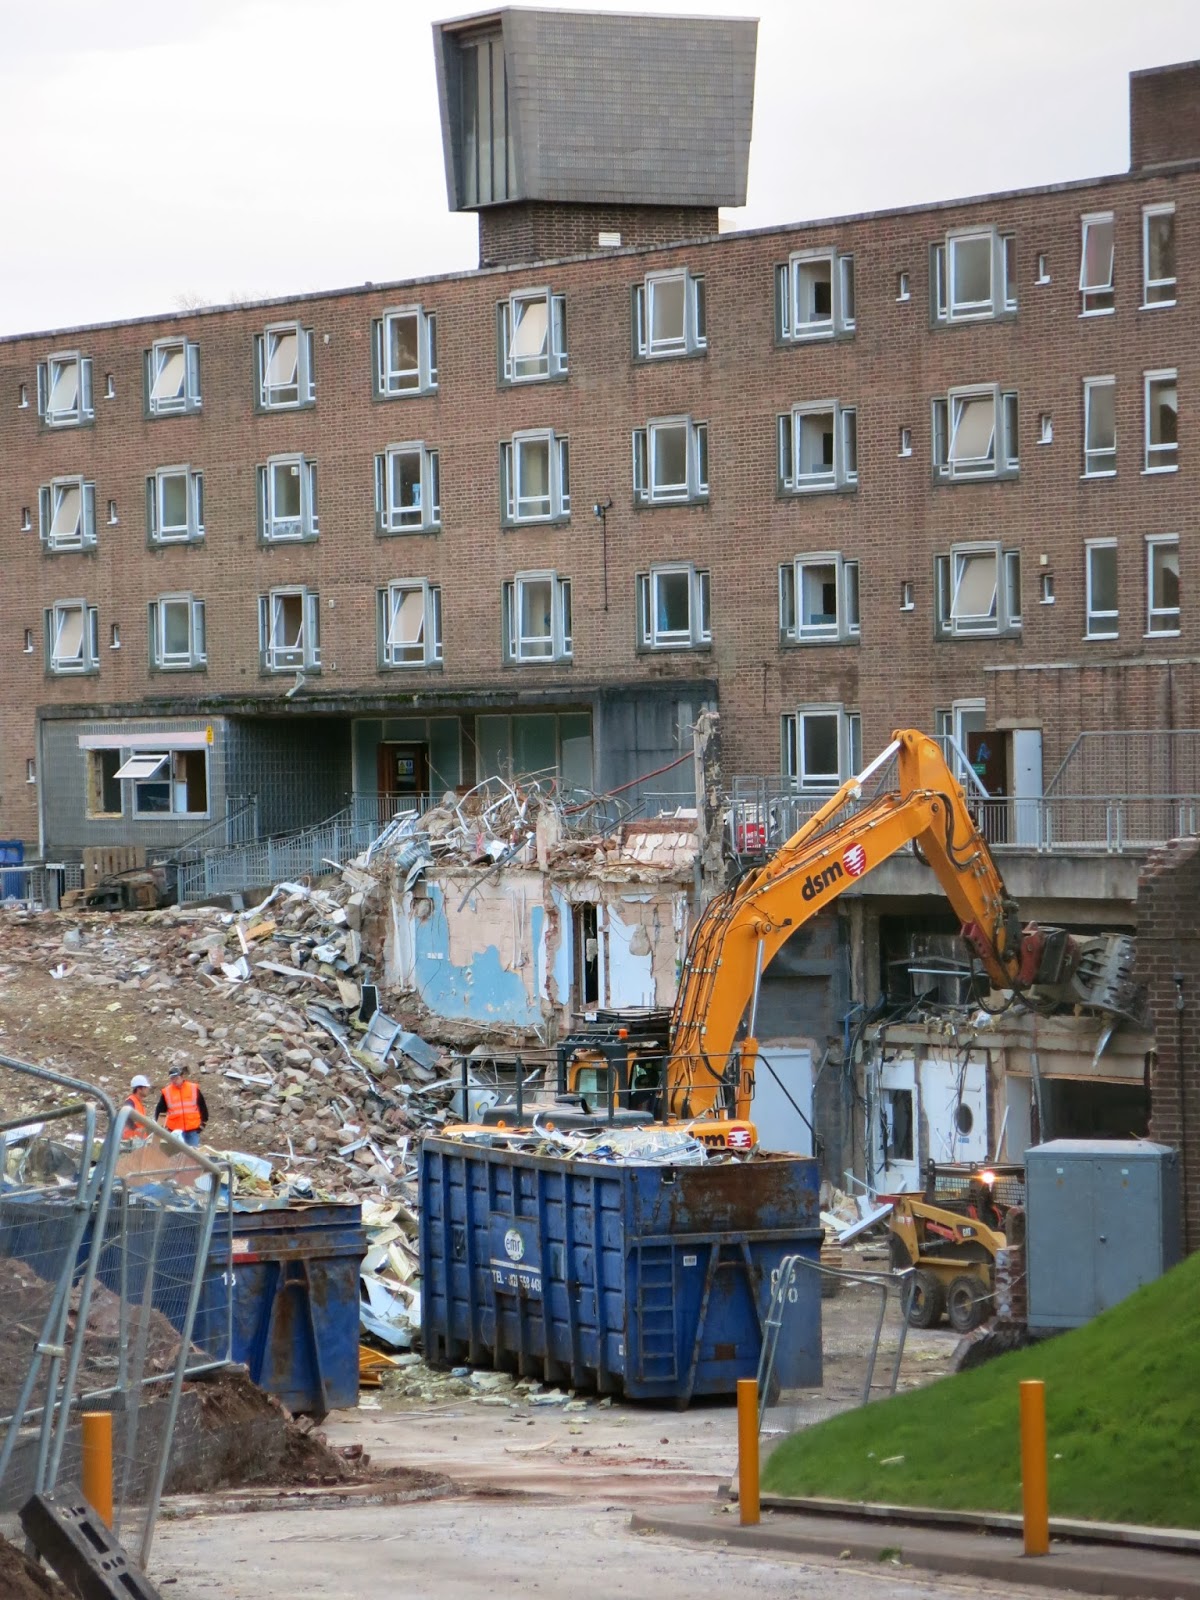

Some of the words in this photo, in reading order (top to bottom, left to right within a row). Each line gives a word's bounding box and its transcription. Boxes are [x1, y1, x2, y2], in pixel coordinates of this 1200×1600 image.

[801, 861, 844, 901] dsm
[505, 1238, 521, 1252] emr
[491, 1269, 505, 1285] TEL
